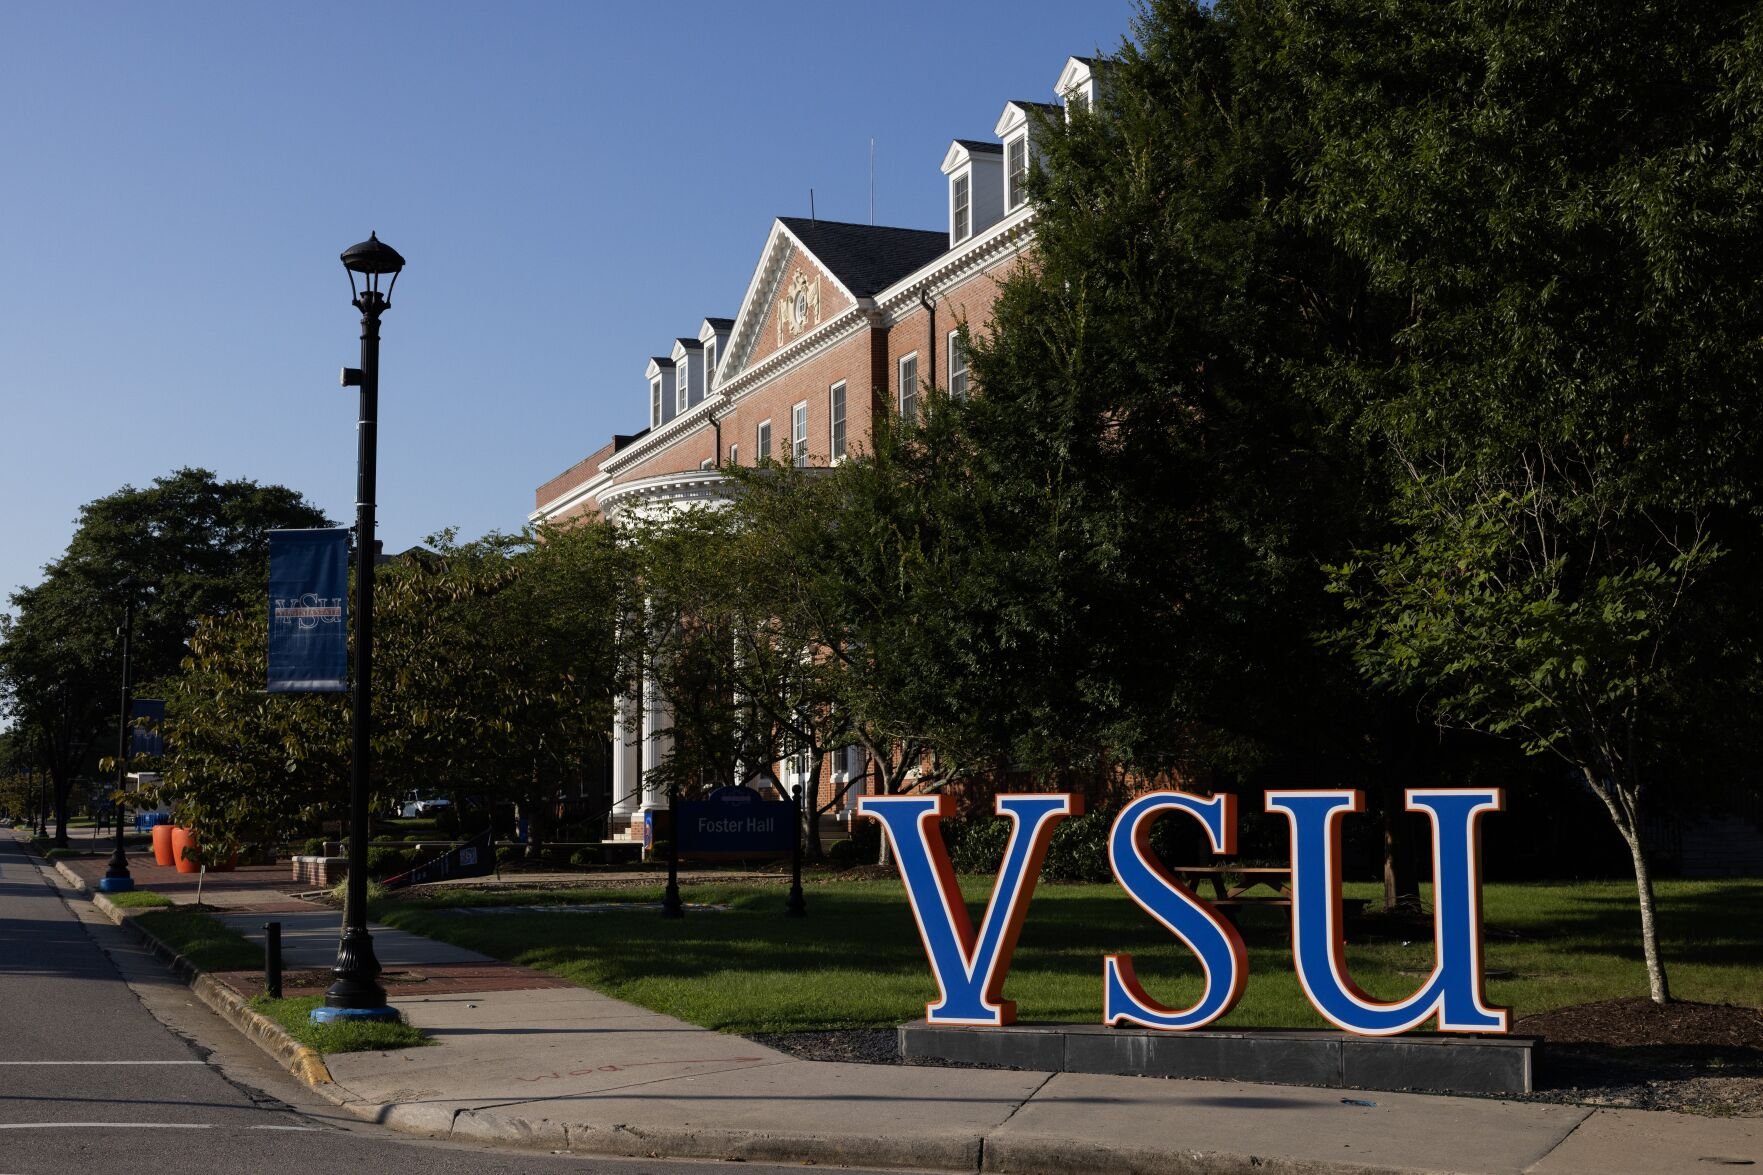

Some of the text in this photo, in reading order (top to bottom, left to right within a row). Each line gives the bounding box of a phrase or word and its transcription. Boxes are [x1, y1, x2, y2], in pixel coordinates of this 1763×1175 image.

[275, 593, 341, 629] VSU
[698, 817, 774, 833] Foster Hall
[857, 787, 1513, 1037] VSU
